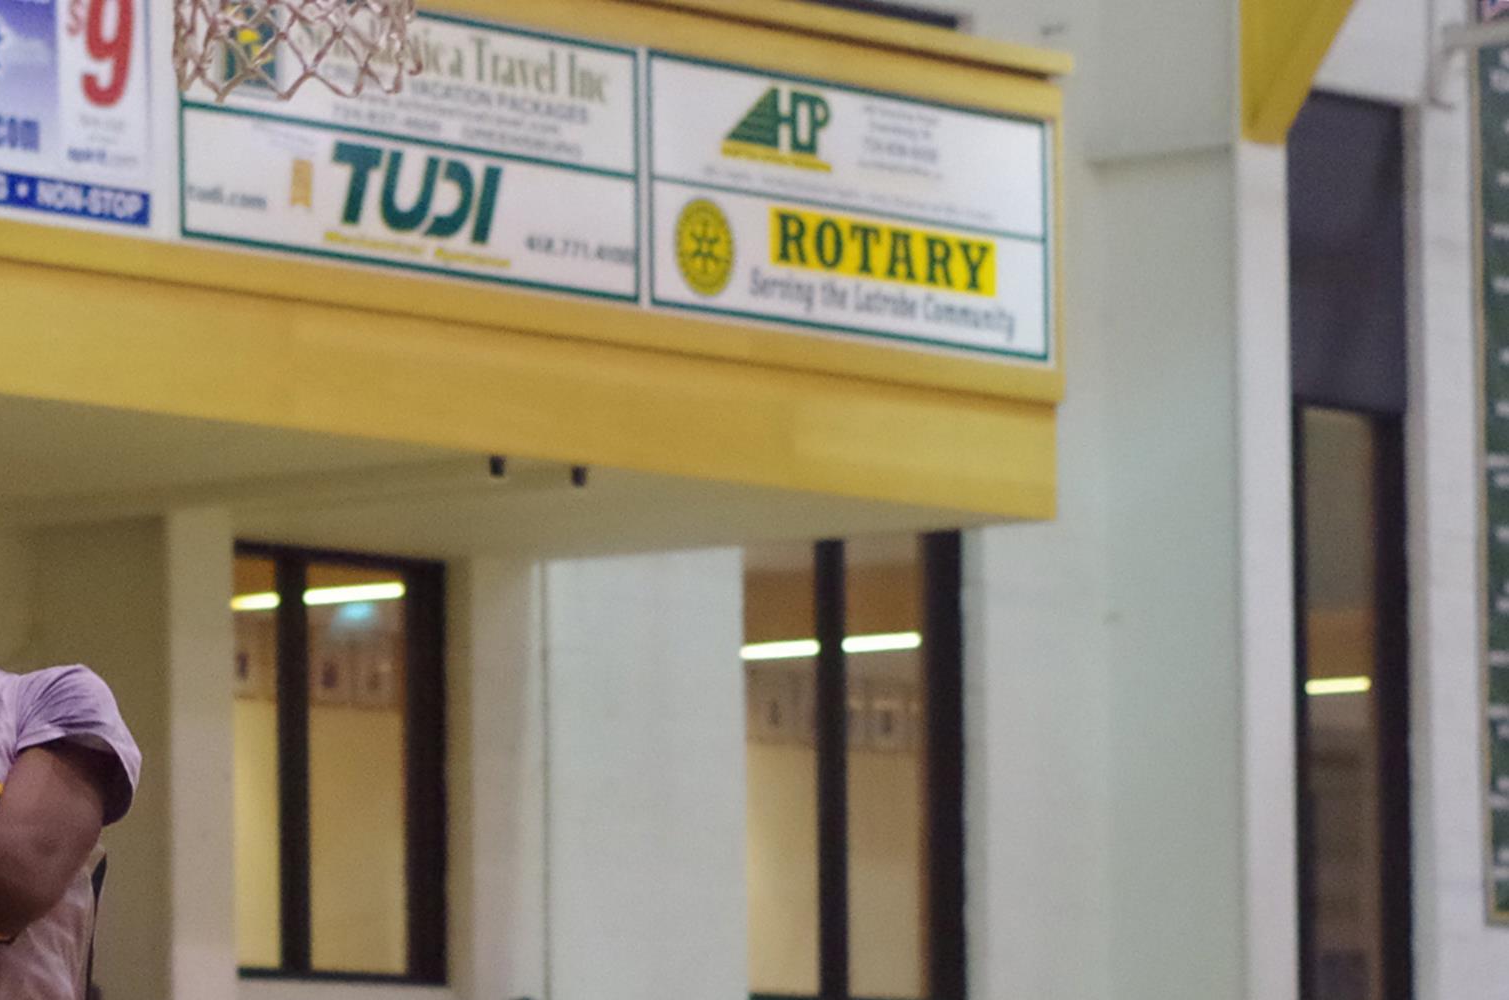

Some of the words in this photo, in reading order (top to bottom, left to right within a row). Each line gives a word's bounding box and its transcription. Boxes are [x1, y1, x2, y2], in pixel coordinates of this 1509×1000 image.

[472, 36, 557, 95] Travel
[568, 51, 610, 102] Inc
[37, 181, 143, 219] NON-STOP
[331, 140, 503, 245] TUDI
[777, 211, 990, 291] ROTARY
[749, 267, 814, 313] Serving
[821, 279, 849, 309] the
